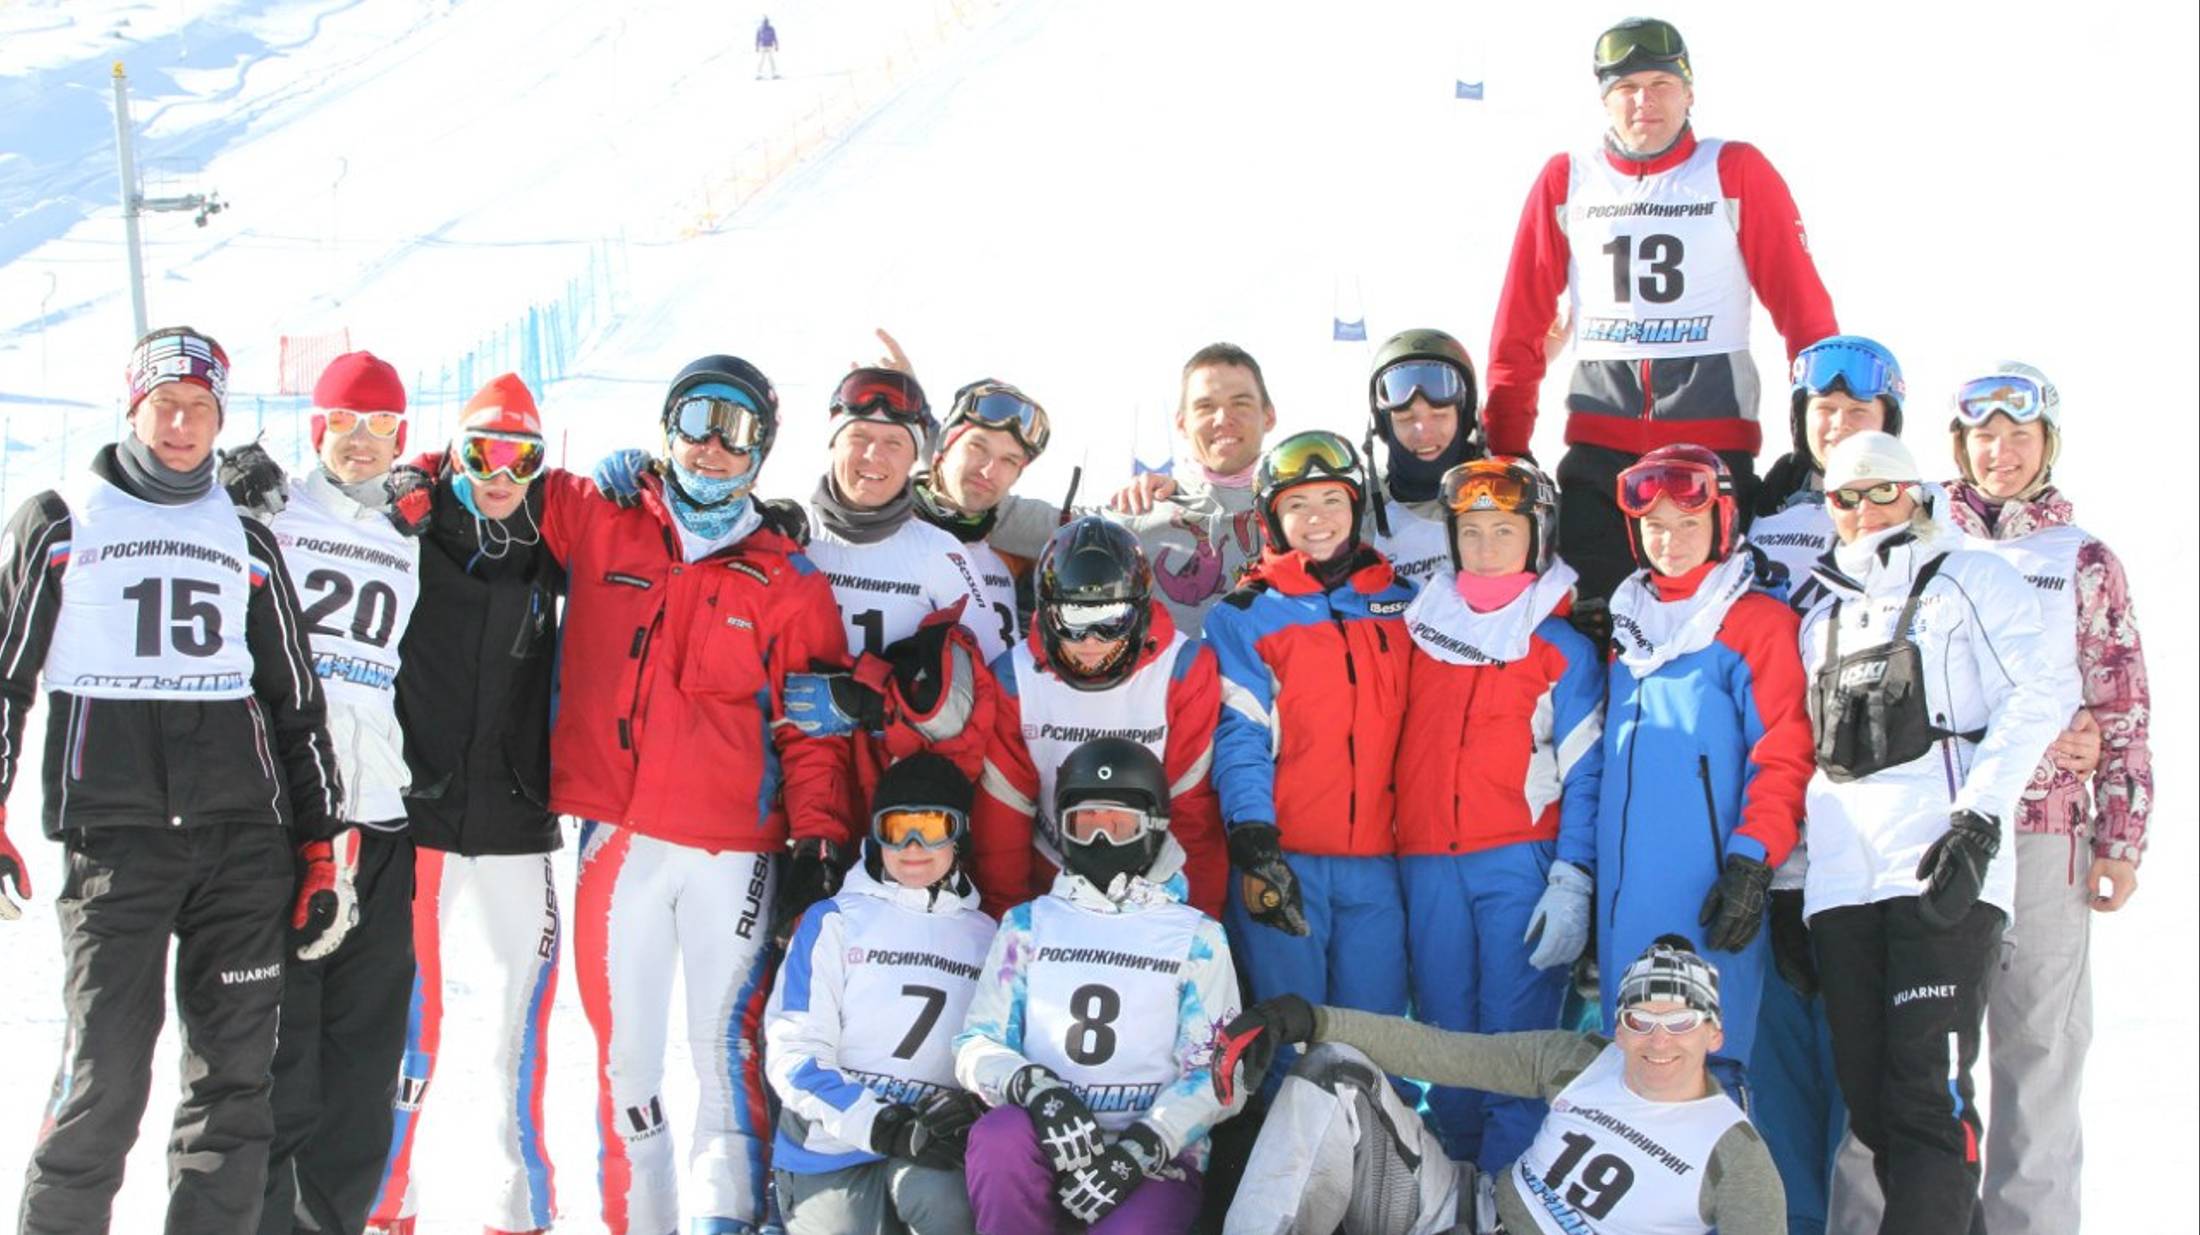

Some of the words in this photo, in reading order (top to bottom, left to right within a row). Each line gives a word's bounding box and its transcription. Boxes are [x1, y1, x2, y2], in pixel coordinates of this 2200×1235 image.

[1586, 201, 1717, 218] РОСИНЖИНИРИНГ
[1603, 233, 1685, 304] 13
[123, 577, 224, 657] 15
[303, 568, 397, 648] 20
[891, 985, 947, 1060] 7
[1065, 984, 1120, 1066] 8
[1893, 985, 1957, 1006] VUARNET
[1542, 1131, 1634, 1221] 19
